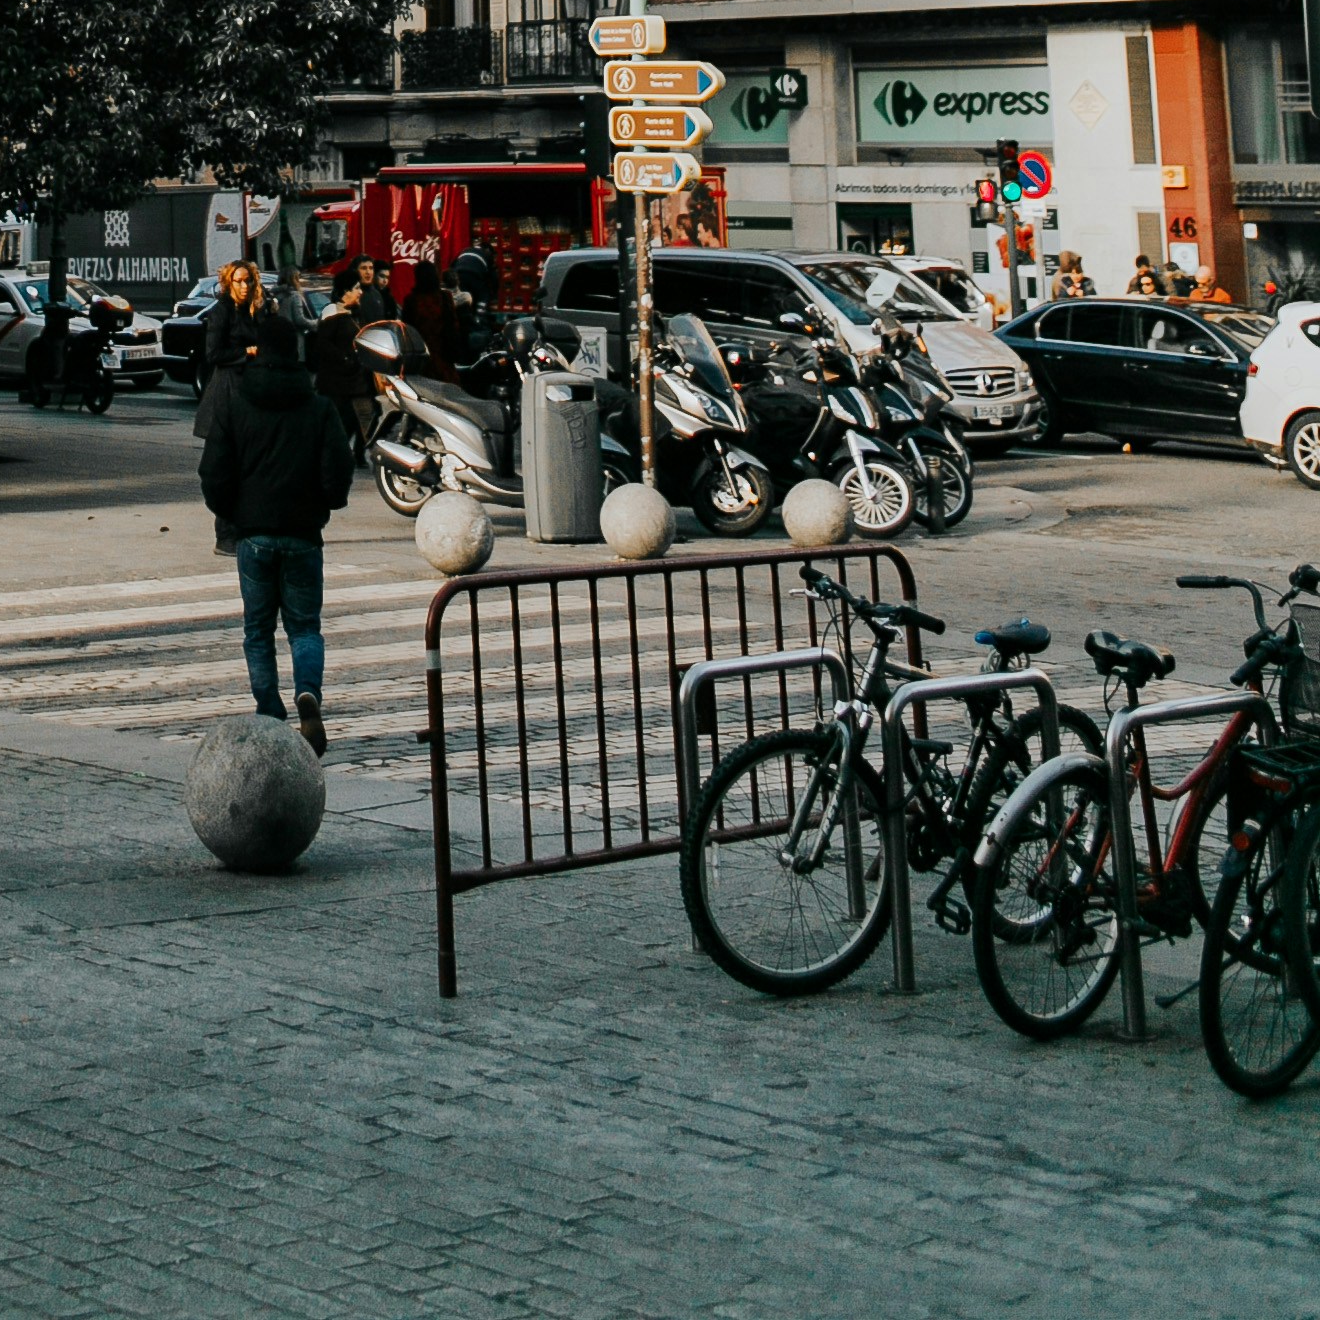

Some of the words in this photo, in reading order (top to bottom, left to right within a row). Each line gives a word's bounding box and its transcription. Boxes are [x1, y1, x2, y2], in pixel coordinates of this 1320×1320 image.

[933, 90, 1050, 123] express
[835, 183, 872, 193] Abrimos
[873, 184, 898, 193] todos
[899, 184, 912, 194] los
[912, 184, 959, 197] domingos
[1169, 216, 1197, 238] 46
[68, 257, 113, 282] RVEZAS
[117, 257, 190, 283] ALHAMBRA
